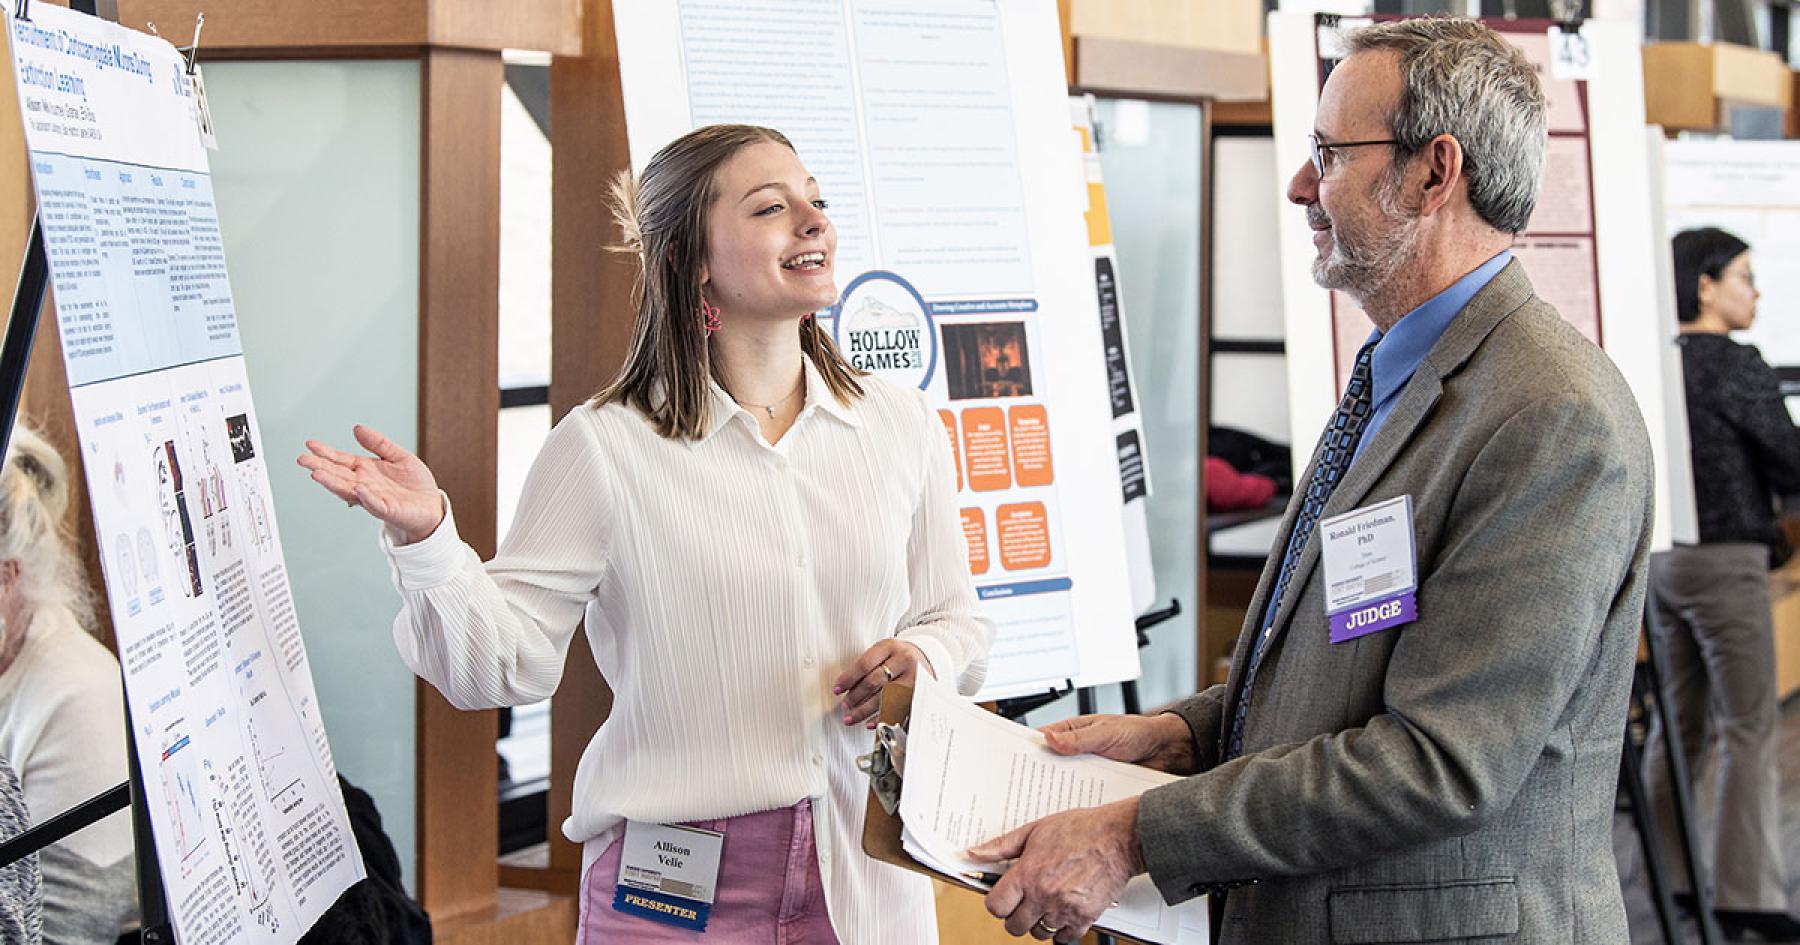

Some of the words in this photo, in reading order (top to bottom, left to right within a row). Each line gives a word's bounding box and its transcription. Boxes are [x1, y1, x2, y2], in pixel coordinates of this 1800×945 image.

[849, 329, 921, 352] HOLLOW
[851, 352, 911, 370] GAMES
[1329, 525, 1357, 541] Ronald
[1357, 534, 1375, 546] PhD
[1346, 600, 1402, 630] JUDGE
[653, 840, 691, 856] Allison
[658, 854, 684, 868] Velie
[624, 893, 698, 920] PRESENTER
